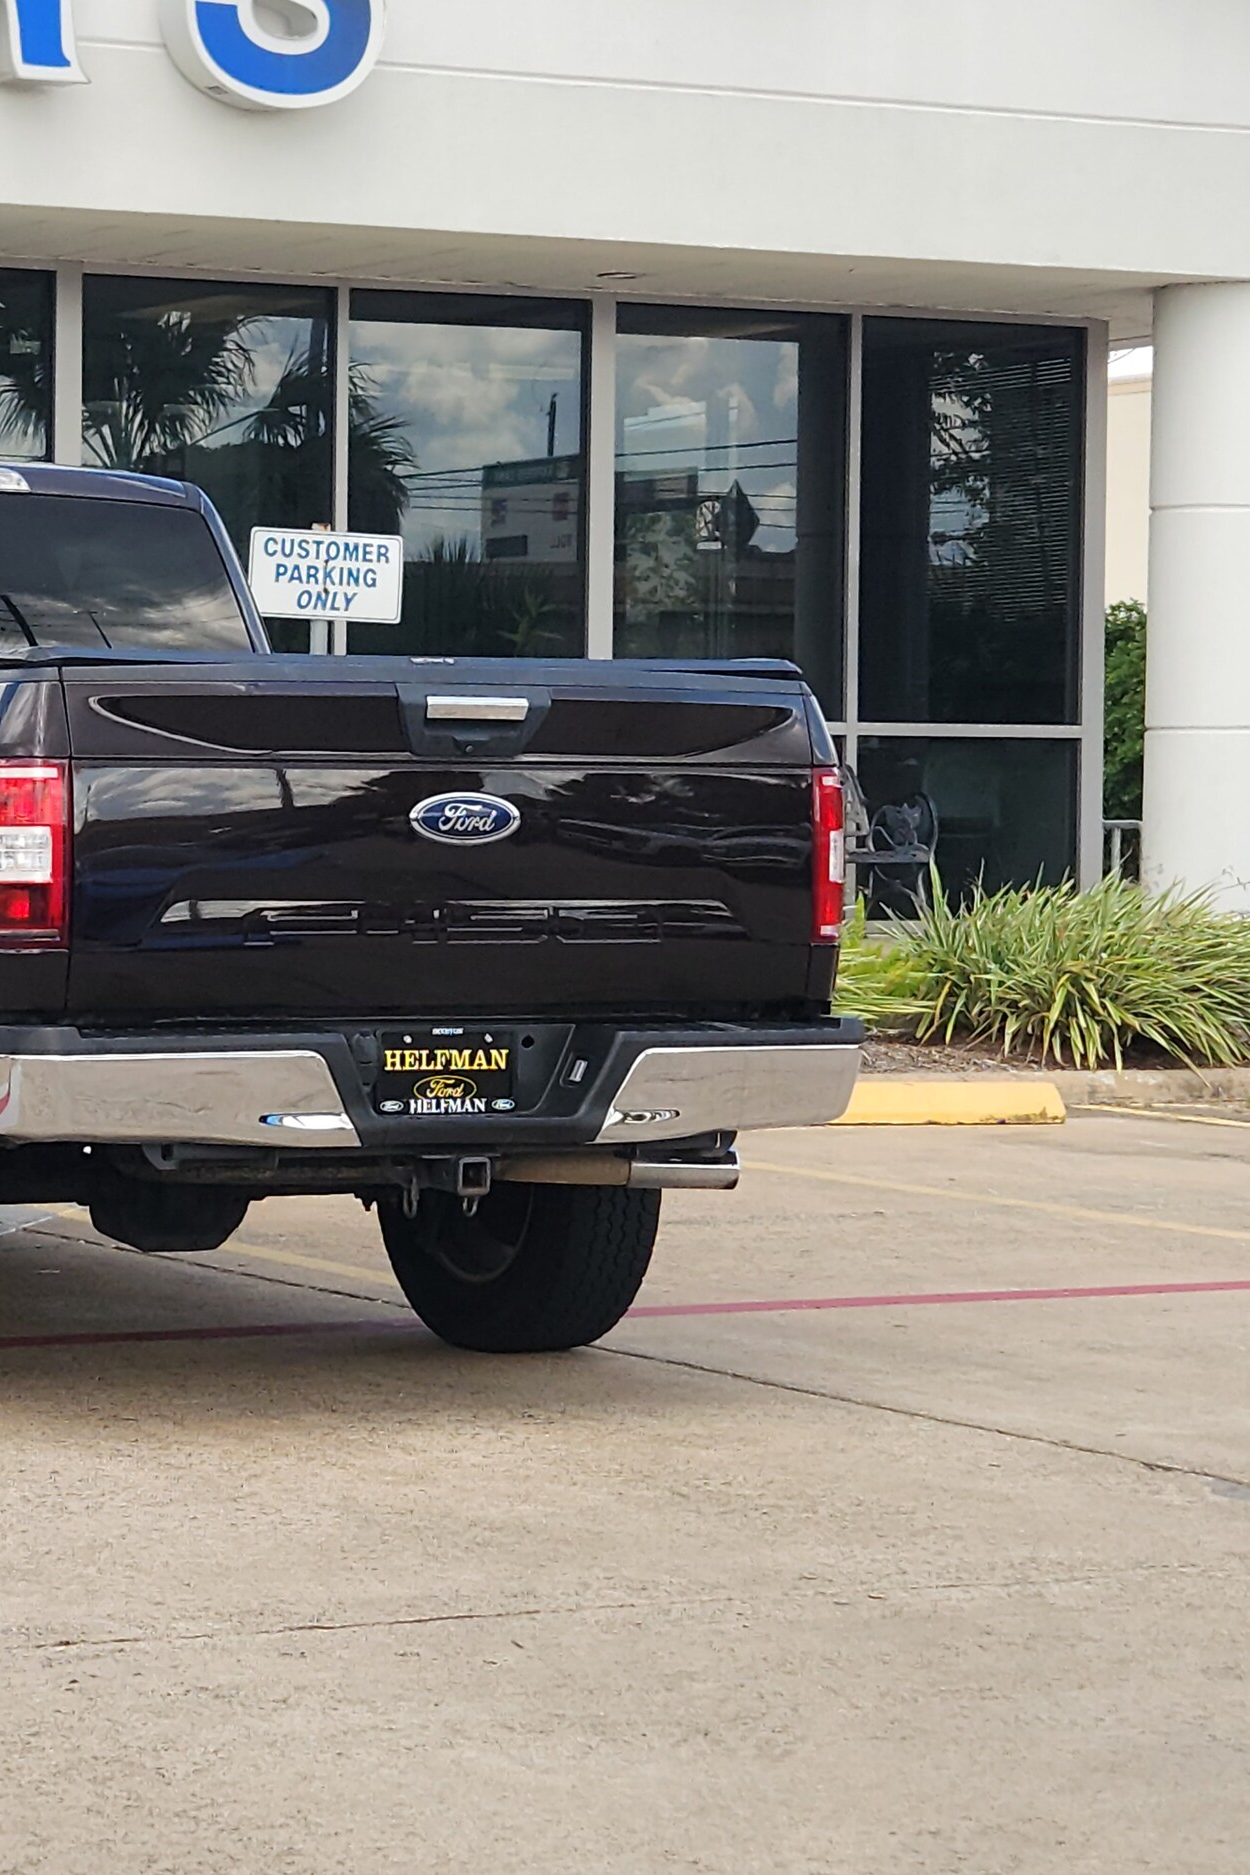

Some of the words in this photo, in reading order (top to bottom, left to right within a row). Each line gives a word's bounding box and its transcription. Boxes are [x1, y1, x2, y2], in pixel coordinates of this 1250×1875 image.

[263, 537, 390, 564] CUSTOMER
[274, 563, 378, 588] PARKING
[296, 590, 358, 612] ONLY
[438, 803, 498, 831] Ford
[384, 1049, 509, 1071] HELFMAN
[425, 1078, 465, 1098] Ford
[409, 1098, 488, 1115] HELFMAN
